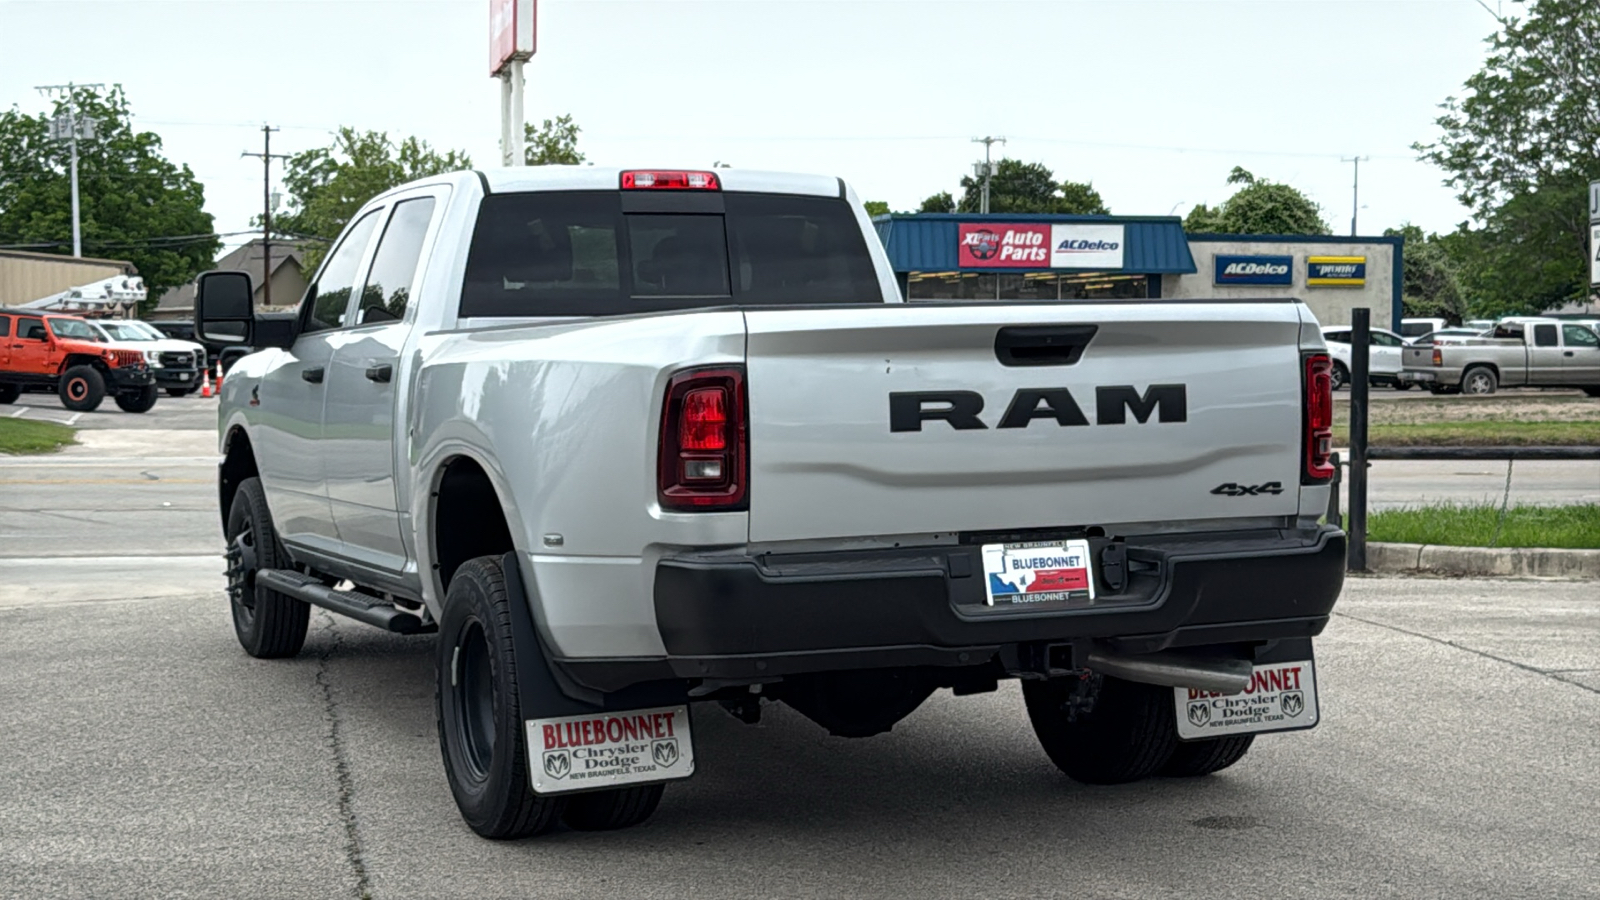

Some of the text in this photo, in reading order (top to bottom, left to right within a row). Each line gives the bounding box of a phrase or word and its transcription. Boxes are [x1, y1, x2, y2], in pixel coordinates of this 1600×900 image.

[1001, 230, 1043, 246] Auto
[1058, 239, 1119, 251] ACDelco
[1000, 245, 1047, 261] Parts
[1224, 262, 1288, 275] ACDelco
[889, 383, 1187, 433] RAM
[1209, 481, 1285, 497] 4x4
[1012, 555, 1081, 570] BLUEBONNET
[1011, 592, 1070, 603] BLUEBONNET
[1212, 694, 1278, 709] Chrysler
[1222, 704, 1270, 718] Dodge
[1209, 720, 1224, 728] NEW
[1264, 713, 1285, 722] TEXAS
[542, 712, 675, 750] BLUEBONNET
[572, 742, 649, 759] Chrysler
[585, 755, 640, 770] Dodge
[569, 772, 586, 780] NEW
[633, 764, 657, 774] TEXAS
